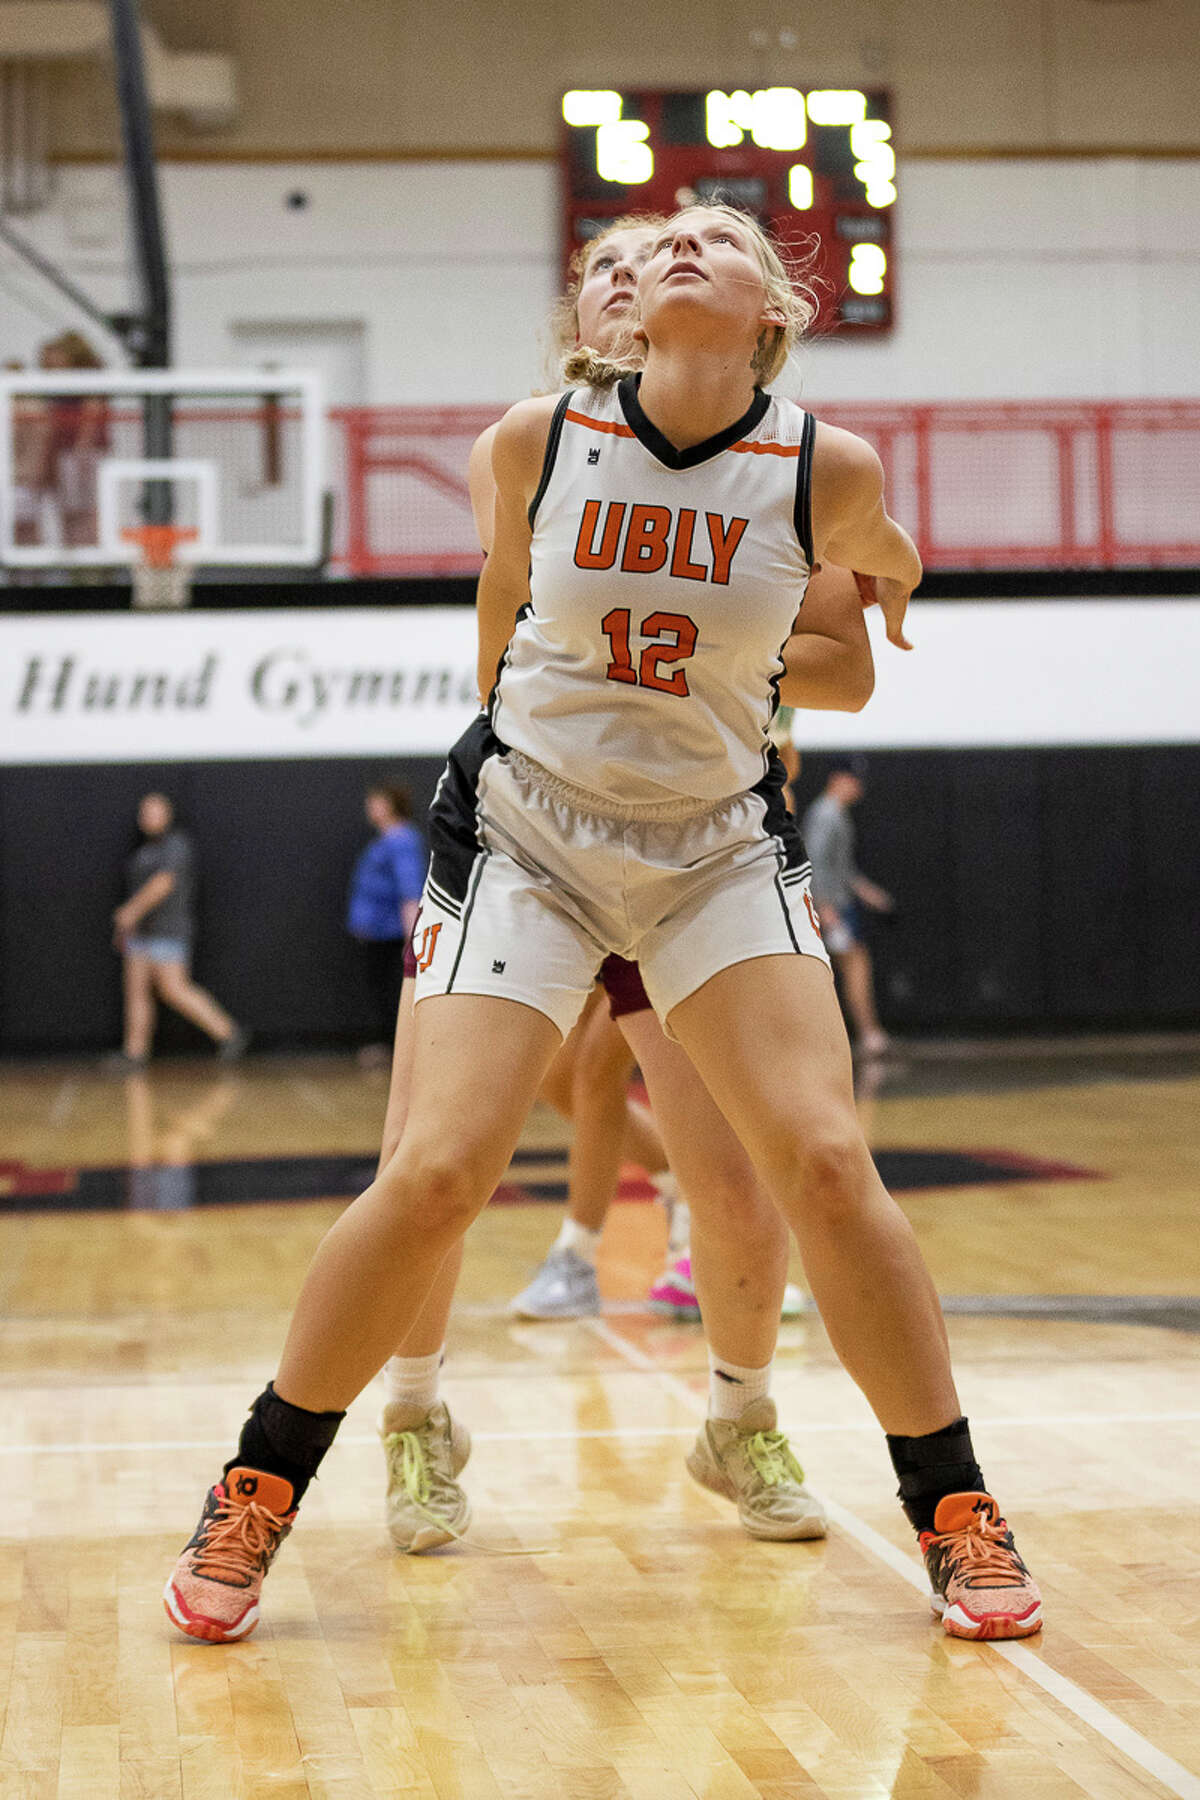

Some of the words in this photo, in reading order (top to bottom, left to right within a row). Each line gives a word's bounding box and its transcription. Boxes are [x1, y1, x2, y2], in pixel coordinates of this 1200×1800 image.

[573, 499, 750, 586] UBLY
[15, 653, 218, 713] Hund
[601, 607, 699, 697] 12
